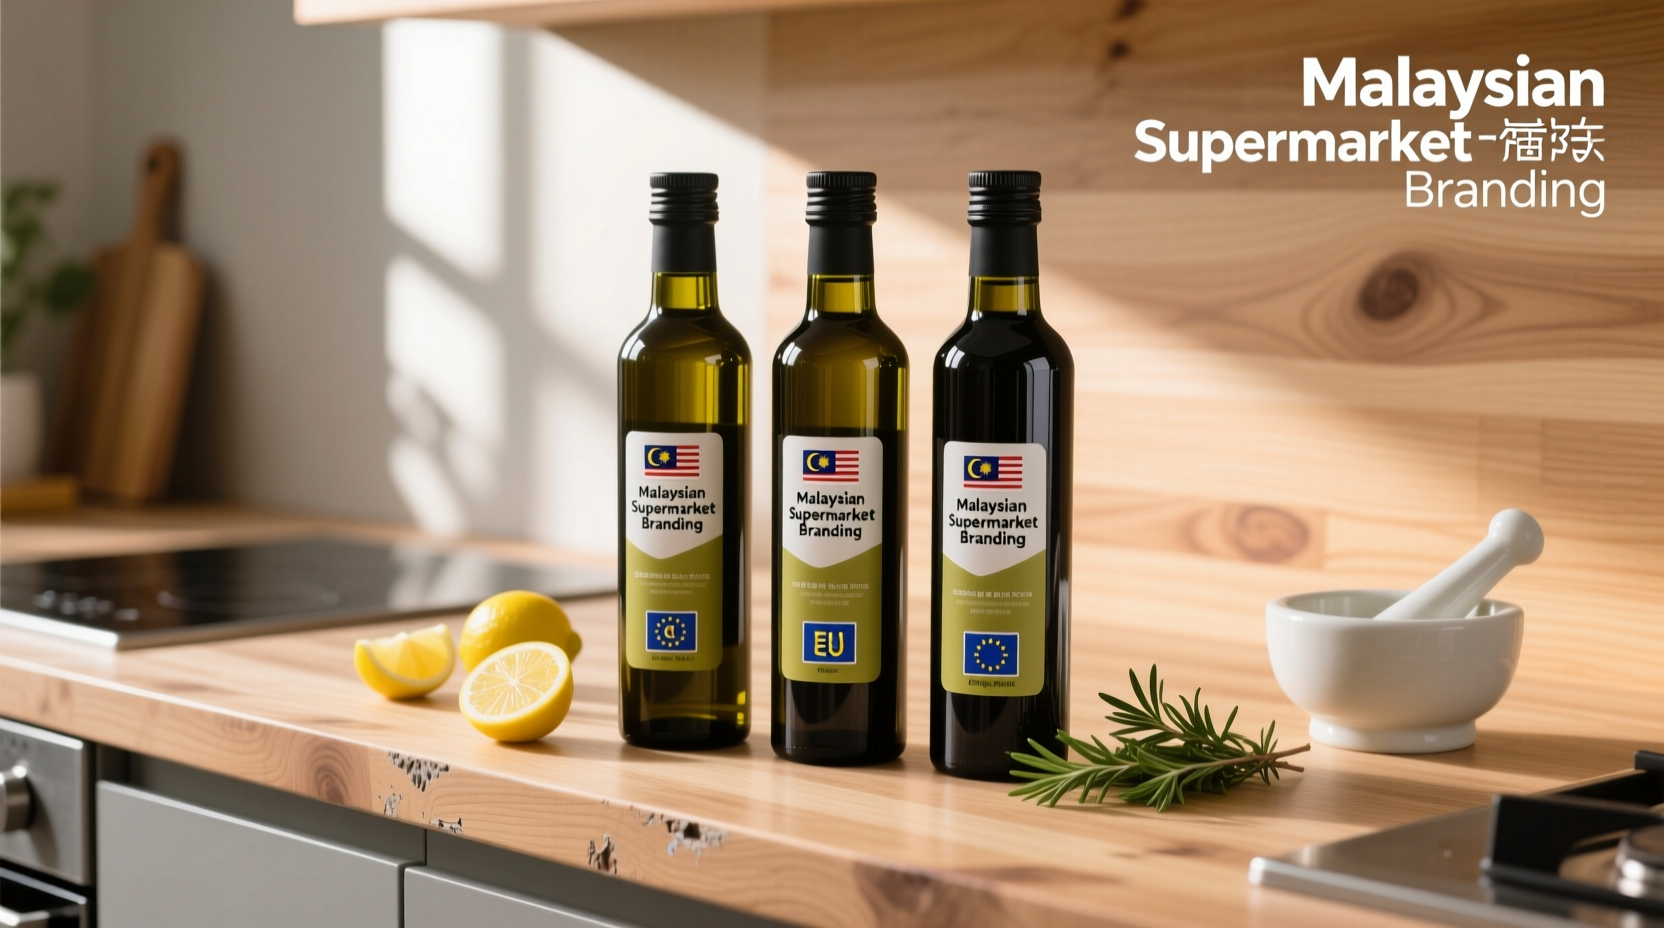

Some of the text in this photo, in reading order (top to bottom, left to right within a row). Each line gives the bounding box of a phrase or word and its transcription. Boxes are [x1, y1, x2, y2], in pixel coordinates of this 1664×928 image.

[639, 485, 706, 501] Malaysian
[797, 490, 865, 509] Malaysian
[631, 500, 717, 517] Supermarket
[956, 497, 1027, 515] Malaysian
[789, 506, 876, 525] Supermarket
[949, 513, 1039, 531] Supermarket
[641, 516, 703, 534] Branding
[799, 523, 862, 542] Branding
[960, 530, 1026, 549] Branding
[814, 631, 845, 657] EU
